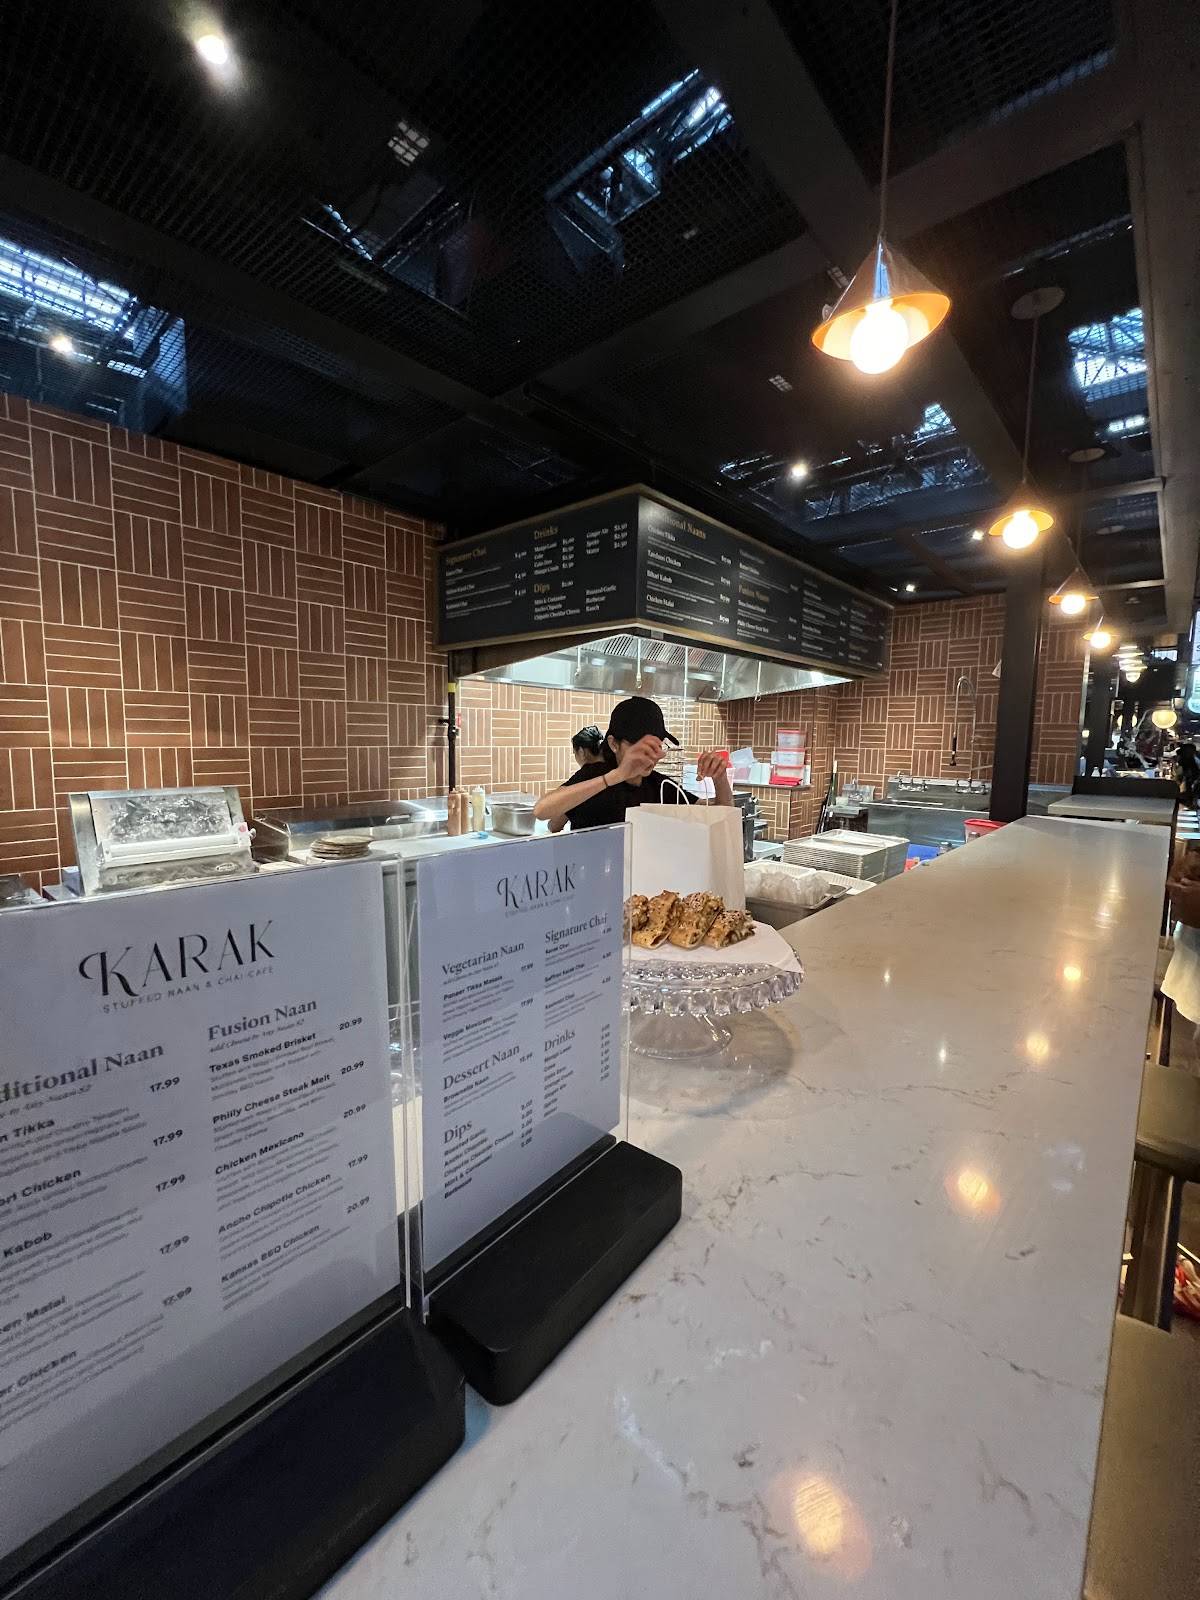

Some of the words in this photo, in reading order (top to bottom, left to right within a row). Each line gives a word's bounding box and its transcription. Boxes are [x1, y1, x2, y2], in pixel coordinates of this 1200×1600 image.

[534, 526, 558, 540] Drinks
[534, 583, 550, 594] Dips
[497, 863, 576, 909] KARAK
[545, 922, 588, 944] Signature
[589, 913, 608, 928] Chai
[78, 919, 275, 997] KARAK
[442, 951, 498, 975] Vegetarian
[500, 942, 525, 957] Naan
[103, 992, 161, 1014] STUFFED
[167, 983, 200, 997] NAAN
[205, 980, 212, 989] &
[217, 974, 243, 985] CHAI
[443, 989, 465, 1000] Paneer
[208, 1016, 271, 1041] Fusion
[274, 1000, 318, 1021] Naan
[338, 1016, 363, 1031] 20.99
[443, 1028, 464, 1041] Veggie
[544, 1029, 576, 1052] Drinks
[104, 1045, 164, 1073] Naan
[208, 1058, 240, 1073] Texas
[242, 1043, 282, 1062] Smoked
[284, 1032, 317, 1049] Brisket
[340, 1060, 365, 1075] 20.99
[443, 1059, 490, 1090] Dessert
[491, 1045, 520, 1066] Naan
[149, 1076, 181, 1093] 17.99
[212, 1106, 243, 1124] Philly
[244, 1093, 281, 1112] Cheese
[282, 1082, 309, 1097] Steak
[310, 1073, 331, 1086] Melt
[342, 1103, 367, 1119] 20.99
[13, 1119, 55, 1138] Tikka
[152, 1129, 183, 1147] 17.99
[444, 1121, 472, 1144] Dips
[215, 1151, 257, 1175] Chicken
[259, 1131, 305, 1155] Mexicano
[348, 1154, 369, 1169] 17.99
[21, 1169, 82, 1198] Chicken
[155, 1174, 186, 1192] 17.99
[218, 1213, 251, 1234] Ancho
[253, 1191, 294, 1216] Chipotle
[295, 1174, 331, 1195] Chicken
[346, 1196, 370, 1214] 20.99
[3, 1231, 53, 1258] Kabob
[159, 1235, 190, 1255] 17.99
[221, 1258, 259, 1283] Kansas
[261, 1245, 282, 1261] BBQ
[283, 1224, 320, 1248] Chicken
[26, 1295, 66, 1321] Malai
[162, 1286, 192, 1306] 17.99
[17, 1350, 77, 1387] Chicken
